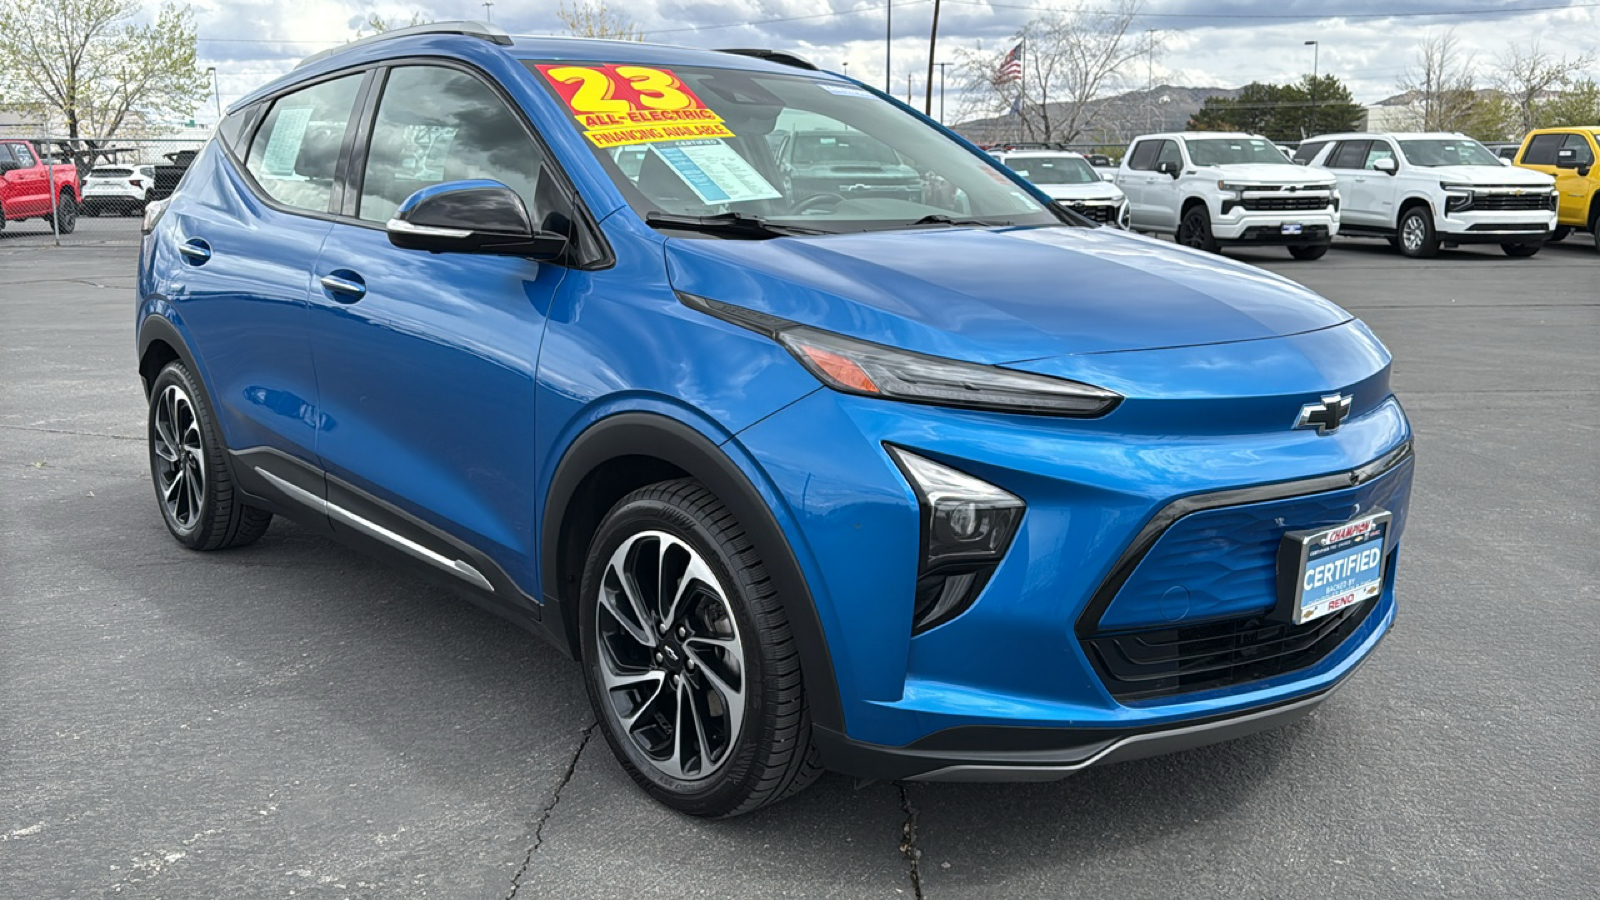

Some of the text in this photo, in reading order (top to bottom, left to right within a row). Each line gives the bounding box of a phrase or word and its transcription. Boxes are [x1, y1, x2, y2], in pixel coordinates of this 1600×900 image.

[547, 66, 697, 115] 23
[585, 109, 718, 128] ALL-ELECTRIC
[591, 124, 730, 146] FINANCING AVAILABLE
[1329, 521, 1370, 542] CHAMPION
[1304, 547, 1380, 591] CERTIFIED
[1325, 580, 1347, 594] BACKED
[1348, 577, 1356, 588] BY
[1328, 593, 1355, 611] RENO
